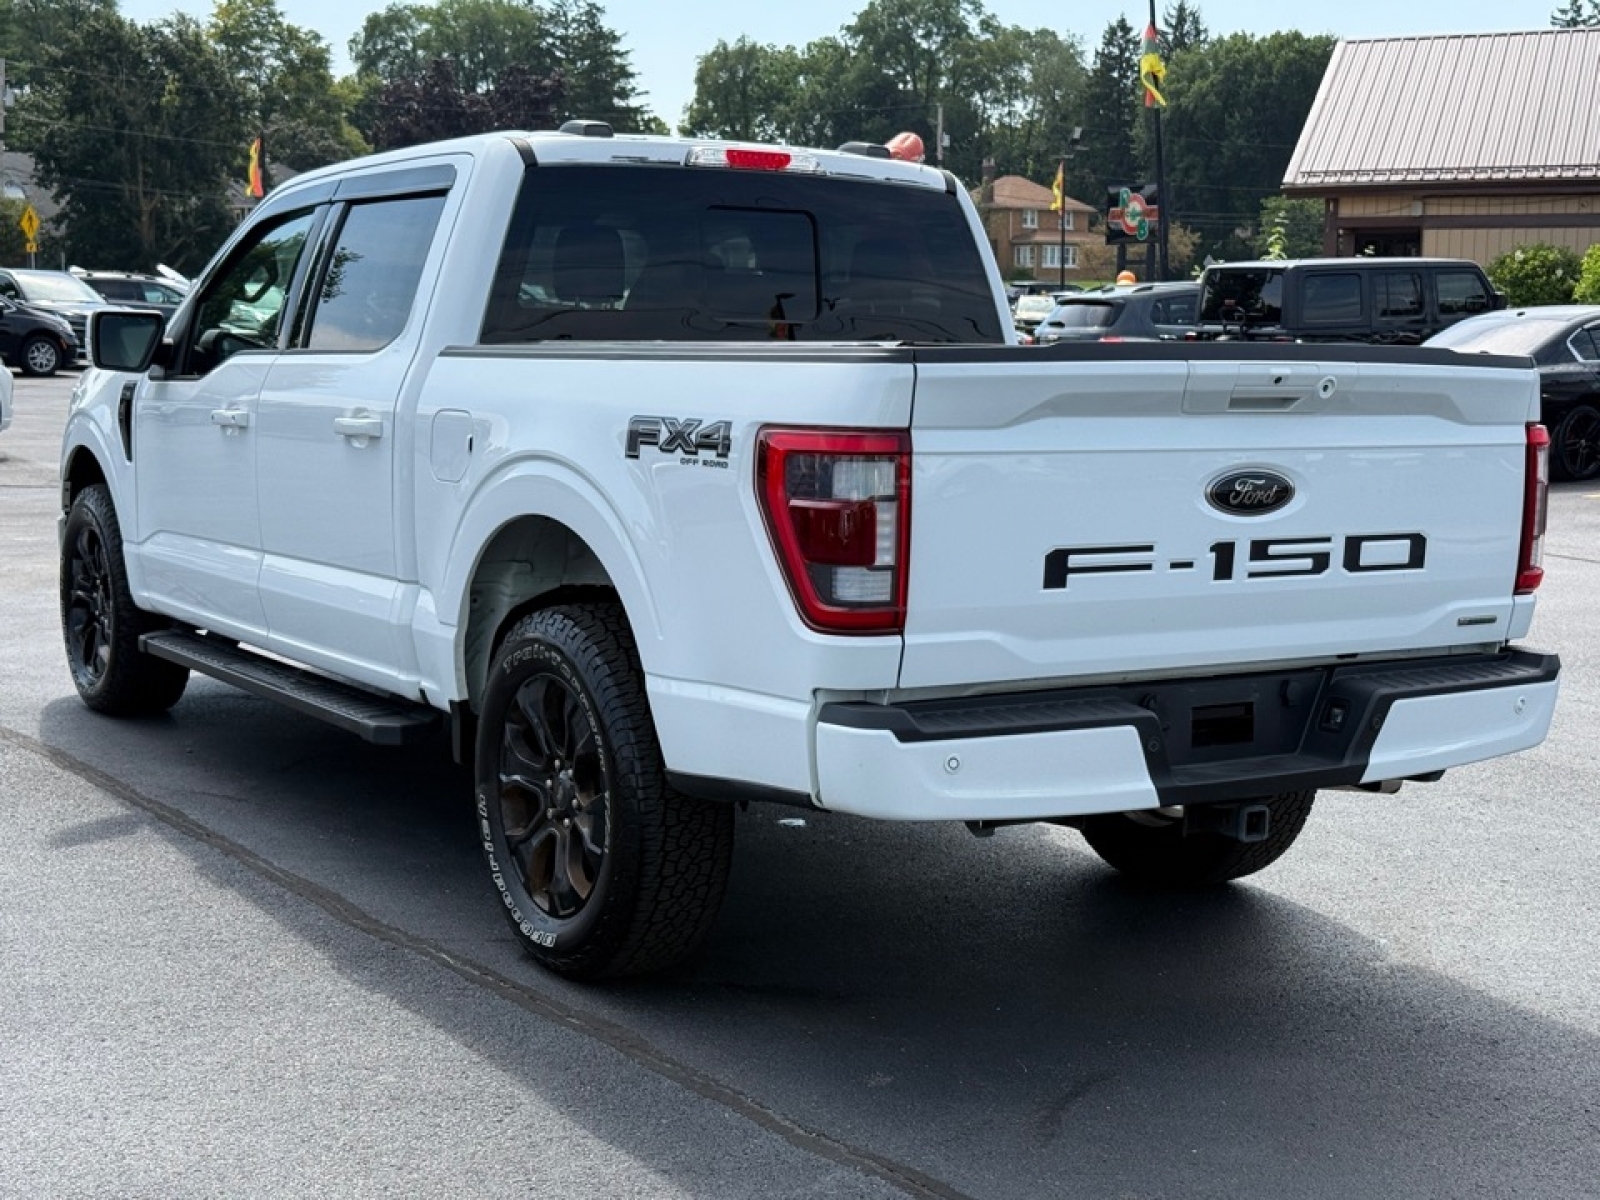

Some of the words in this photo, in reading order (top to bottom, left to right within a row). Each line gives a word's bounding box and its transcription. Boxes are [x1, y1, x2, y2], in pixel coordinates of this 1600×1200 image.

[625, 415, 733, 460] FX4
[680, 458, 699, 466] OFF
[702, 459, 729, 469] ROAD
[1229, 478, 1278, 505] Ford
[1042, 532, 1427, 590] F-150
